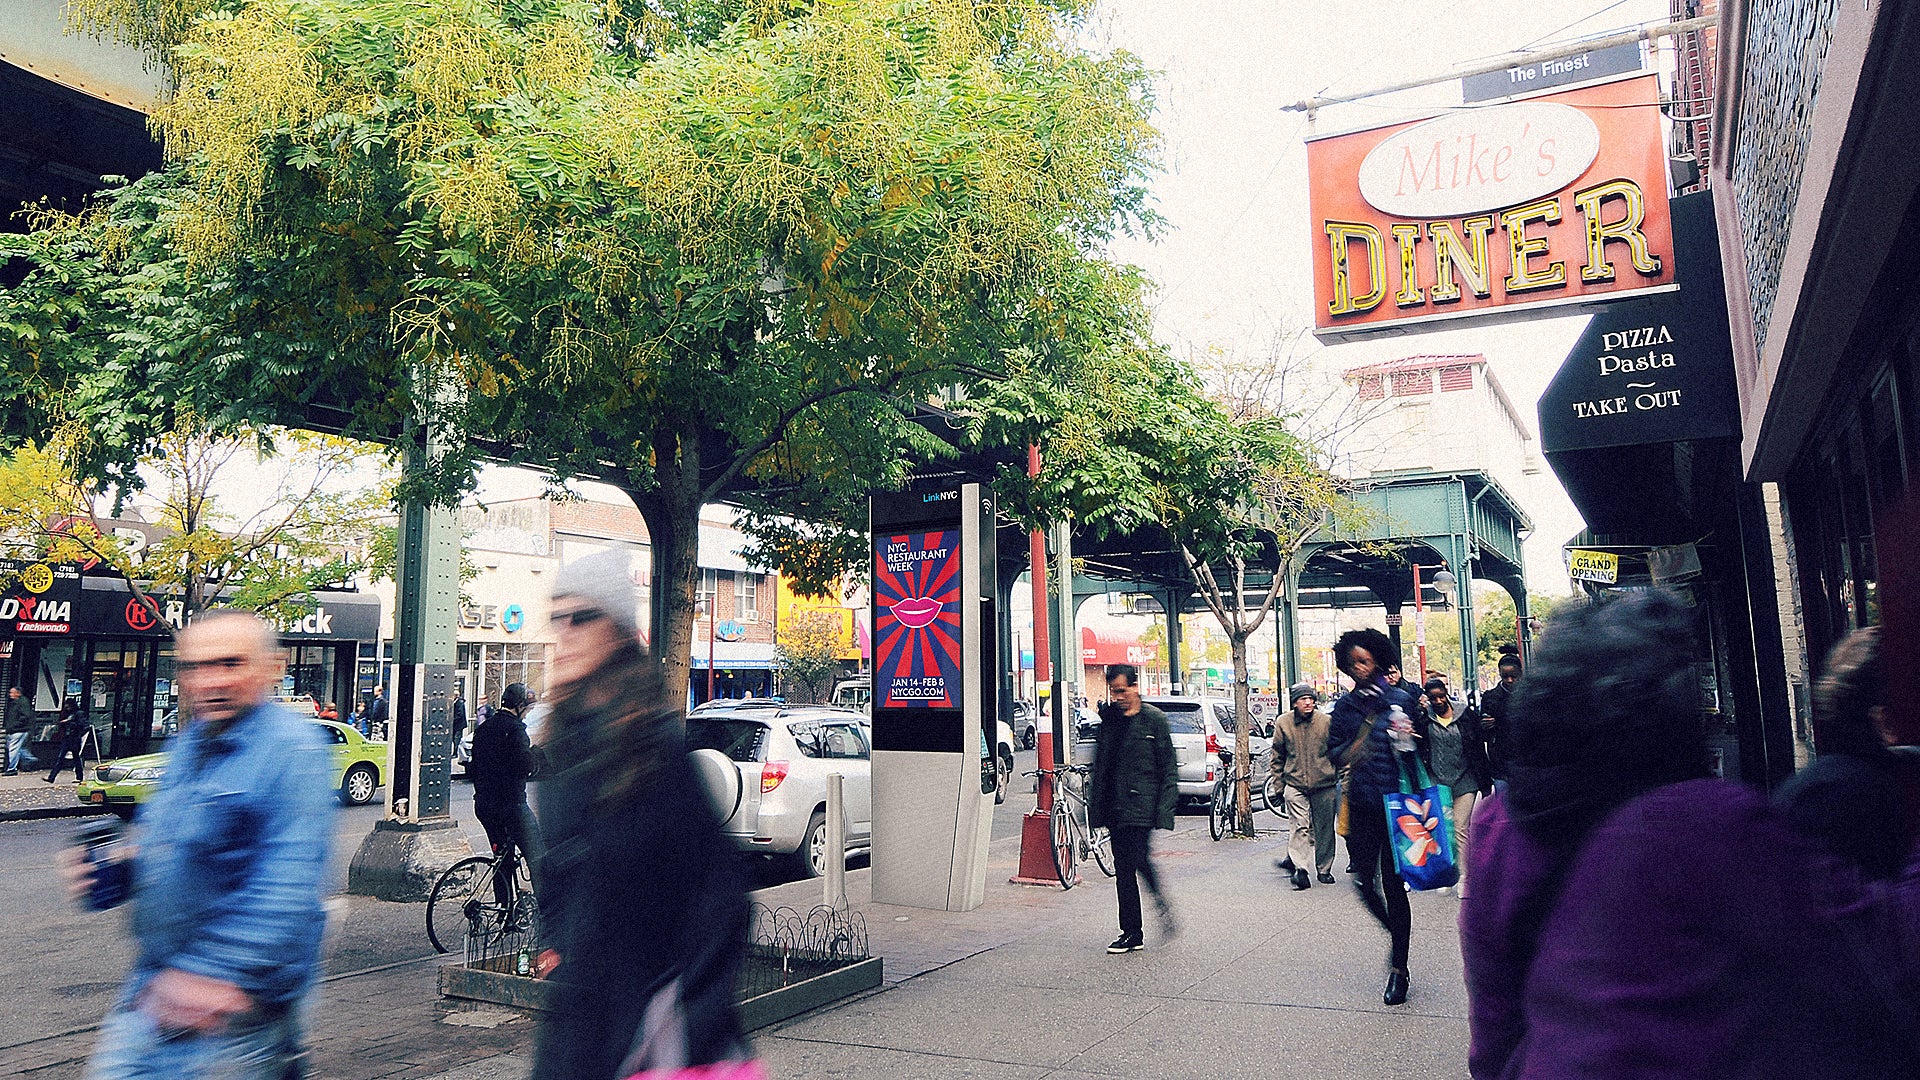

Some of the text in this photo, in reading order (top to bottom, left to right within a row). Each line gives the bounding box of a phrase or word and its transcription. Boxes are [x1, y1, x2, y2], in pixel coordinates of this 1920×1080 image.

[1507, 53, 1590, 83] The Finest
[1394, 122, 1557, 197] Mike's
[1324, 177, 1661, 319] DINER
[1602, 325, 1675, 352] PIZZA
[1597, 350, 1677, 376] Pasta
[1573, 389, 1682, 418] TAKE OUT
[923, 490, 958, 503] LinkNYC
[887, 542, 907, 554] NYC
[887, 548, 947, 563] RESTAURANT
[887, 561, 914, 573] WEEK
[1576, 557, 1611, 570] GRAND
[1571, 567, 1615, 581] OPENING
[18, 622, 68, 633] Taekwondo
[891, 678, 908, 687] JAN
[938, 677, 945, 687] 8
[891, 687, 944, 697] NYCGO.COM
